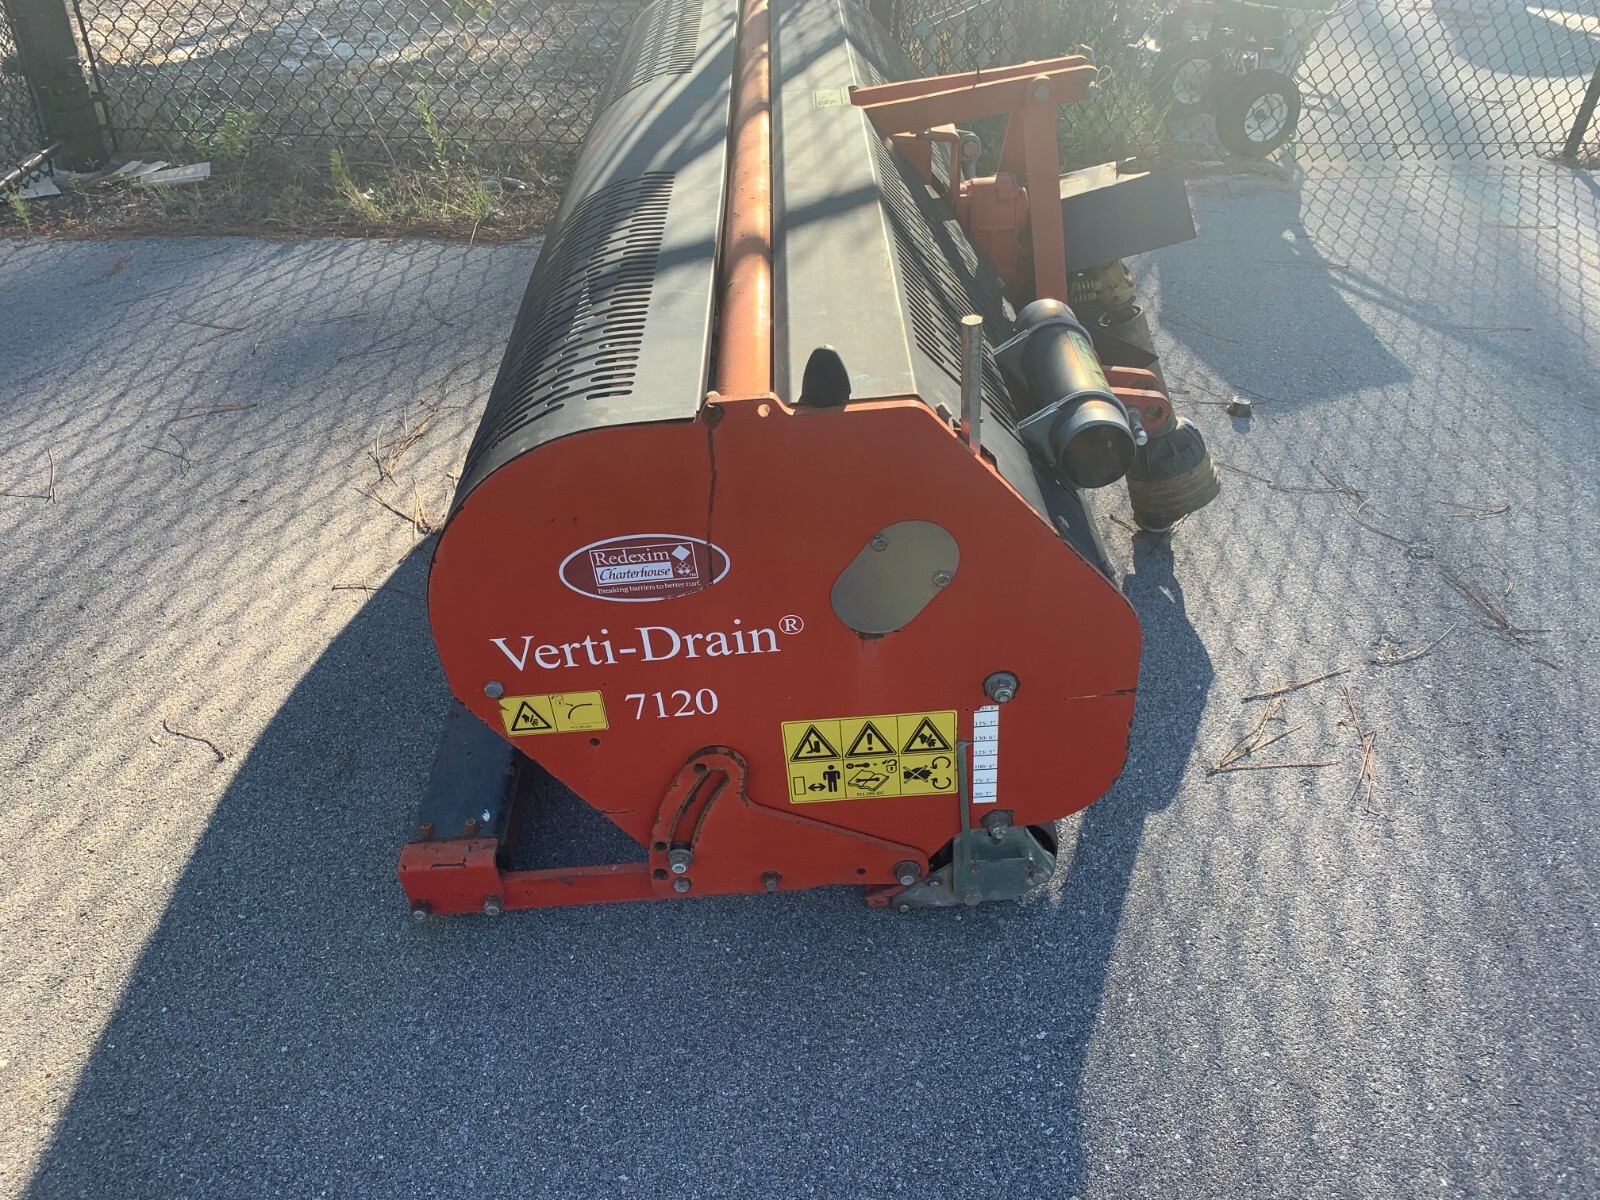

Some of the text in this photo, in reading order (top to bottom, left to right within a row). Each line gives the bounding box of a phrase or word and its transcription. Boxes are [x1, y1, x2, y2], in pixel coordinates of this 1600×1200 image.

[593, 548, 670, 566] Redexim
[600, 565, 671, 581] Charterhouse
[598, 587, 629, 595] Breaking
[629, 584, 656, 592] barriers
[664, 580, 685, 588] better
[625, 688, 718, 720] 7120
